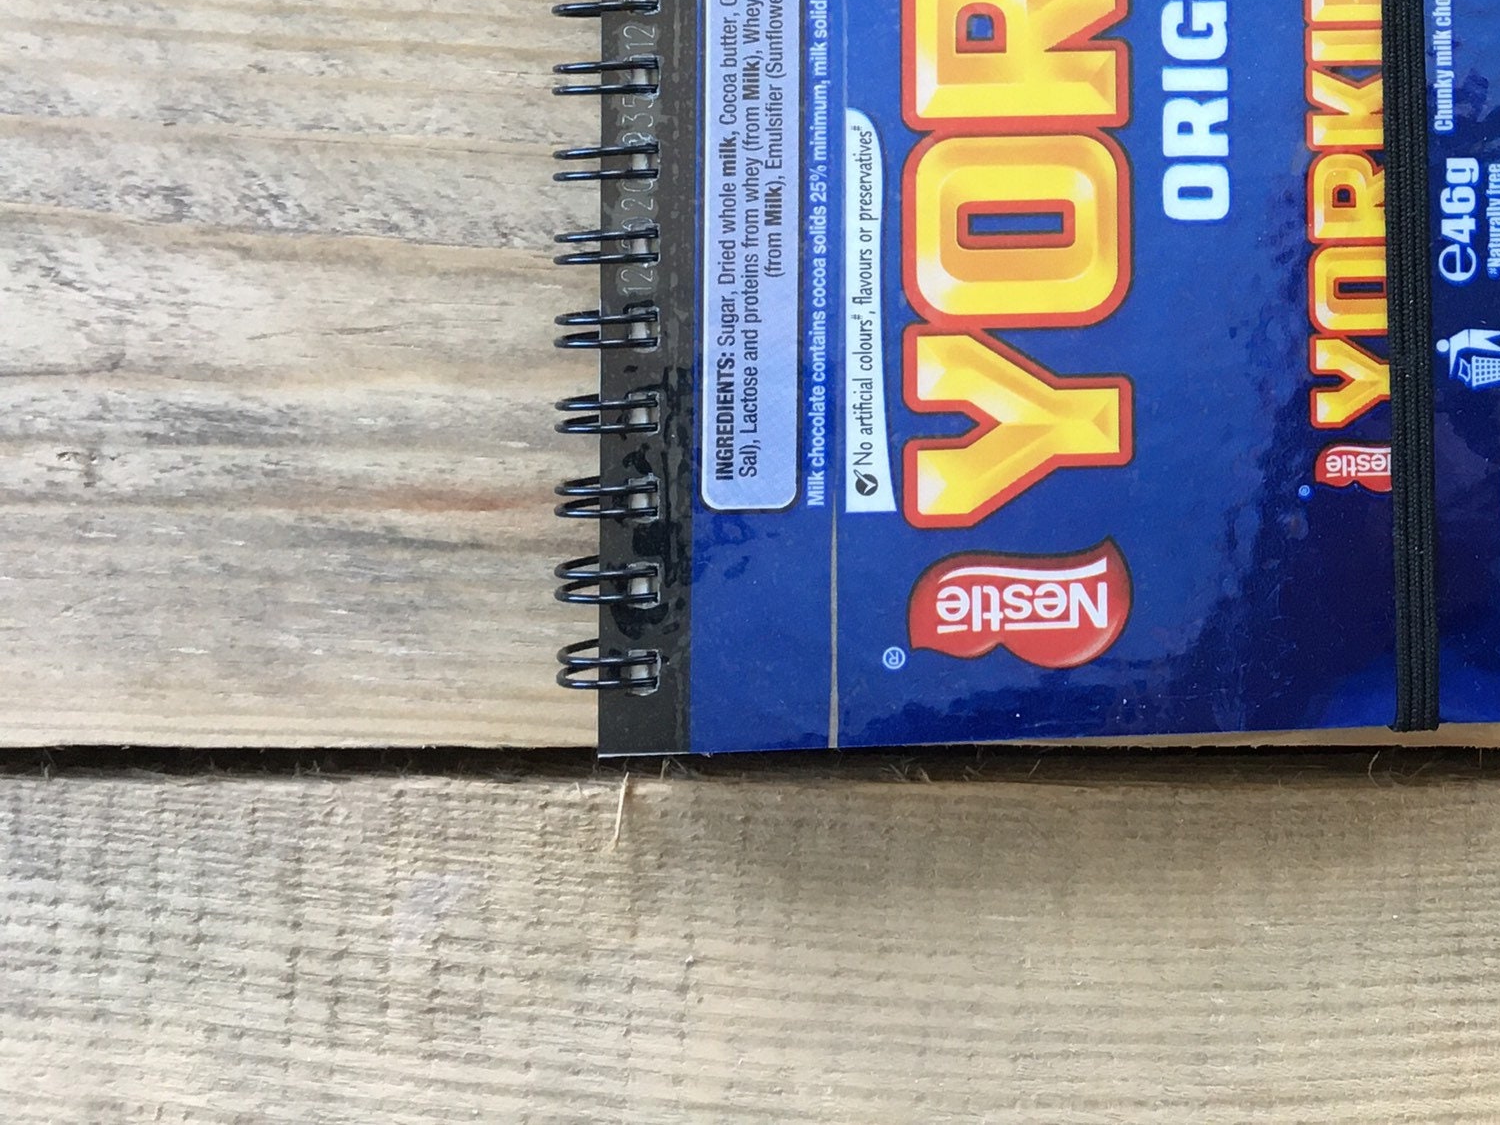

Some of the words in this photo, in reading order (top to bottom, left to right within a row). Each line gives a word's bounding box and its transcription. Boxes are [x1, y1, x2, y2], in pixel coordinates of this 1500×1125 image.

[720, 13, 740, 67] butter,
[809, 41, 828, 76] milk
[1432, 30, 1452, 66] milk
[719, 73, 737, 125] Cocoa
[809, 80, 830, 163] minimum,
[1432, 69, 1456, 131] Chunky
[764, 84, 783, 169] Emulsifier
[718, 131, 740, 177] milk,
[718, 183, 737, 234] whole
[764, 176, 786, 226] Milk),
[809, 165, 827, 202] 25%
[764, 232, 786, 277] (from
[806, 206, 827, 254] solids
[859, 227, 872, 242] or
[717, 240, 736, 285] Dried
[812, 258, 826, 308] cocoa
[852, 249, 872, 305] flavours
[717, 291, 739, 347] Sugar,
[808, 311, 826, 382] contains
[715, 352, 740, 481] INGREDIENTS:
[807, 385, 826, 468] chocolate
[852, 378, 873, 435] artificial
[853, 442, 873, 465] No
[1325, 453, 1391, 477] estlé
[807, 469, 826, 506] Milk
[936, 582, 1107, 634] Nestlé
